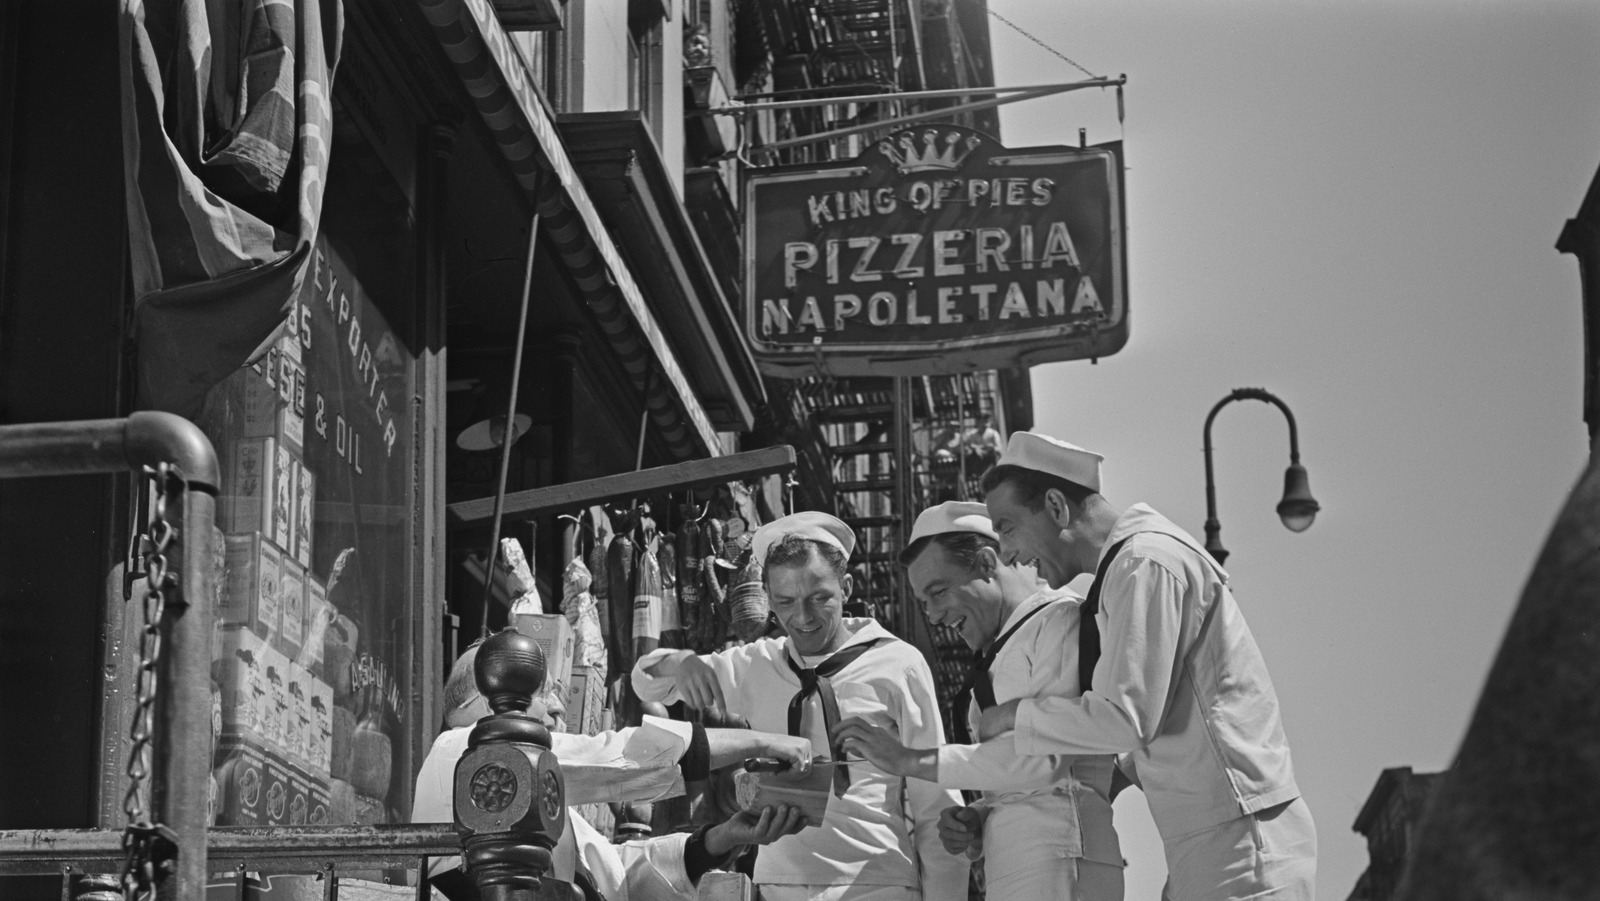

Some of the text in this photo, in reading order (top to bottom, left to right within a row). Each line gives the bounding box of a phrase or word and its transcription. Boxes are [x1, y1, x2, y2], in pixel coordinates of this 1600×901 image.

[807, 177, 1056, 226] KING OF PIES
[784, 221, 1082, 289] PIZZERIA
[761, 275, 1105, 336] NAPOLETANA
[314, 247, 397, 458] EXPORTER
[252, 345, 305, 419] ESE
[336, 413, 363, 475] OIL
